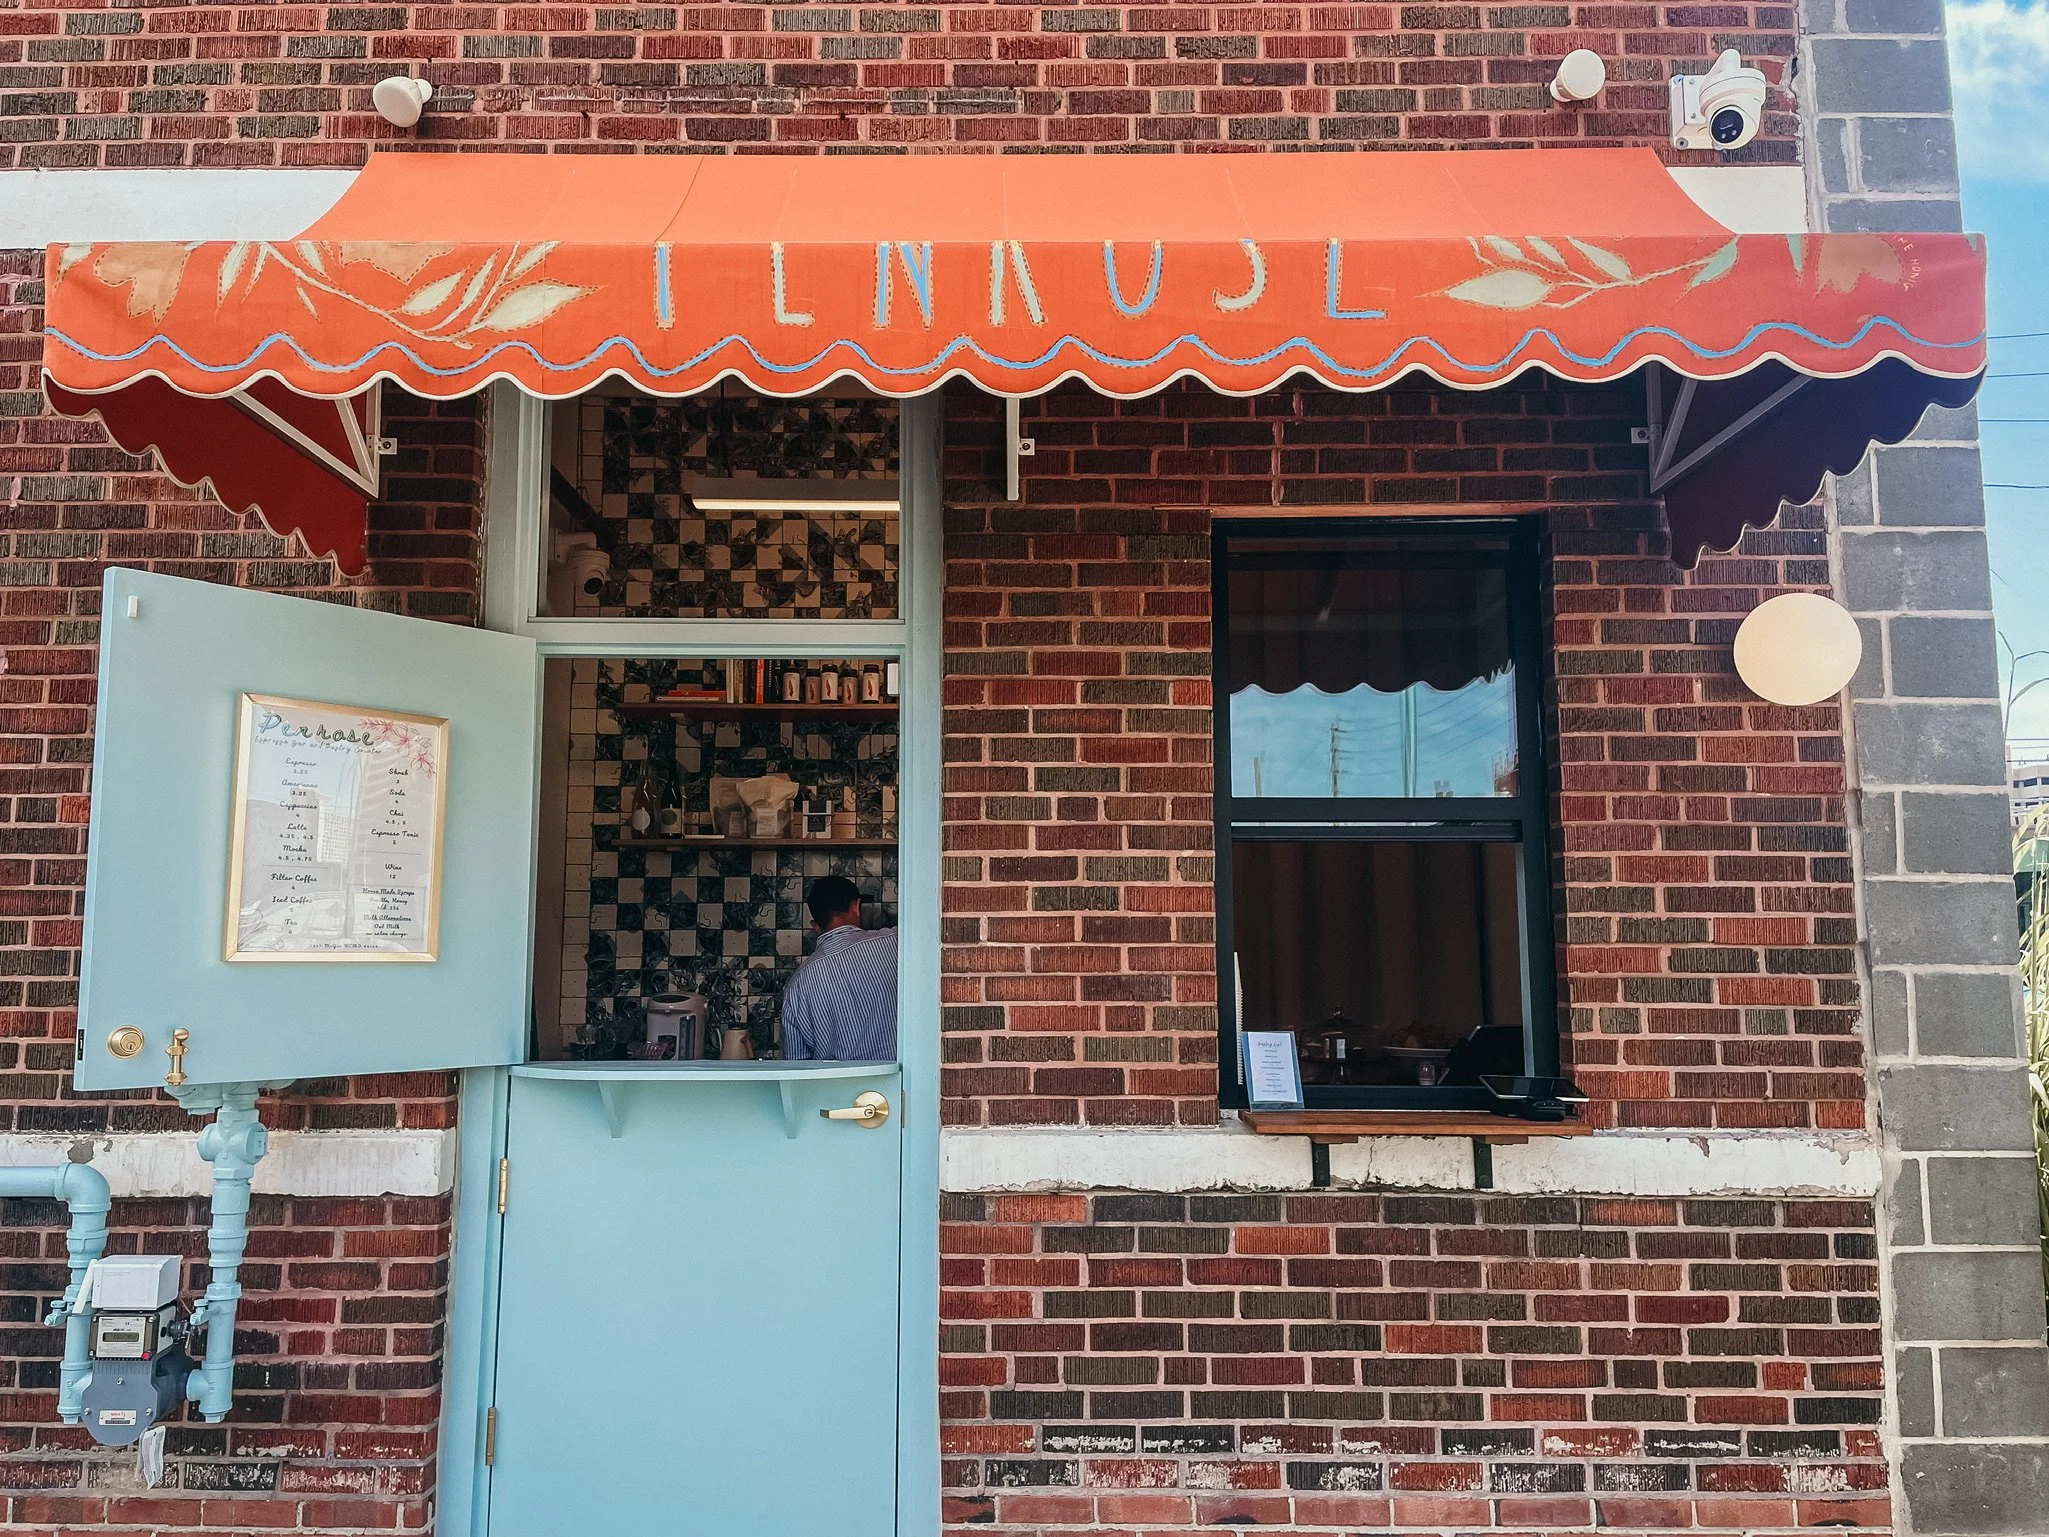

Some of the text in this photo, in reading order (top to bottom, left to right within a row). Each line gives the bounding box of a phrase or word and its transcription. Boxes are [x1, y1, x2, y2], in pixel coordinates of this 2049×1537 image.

[258, 712, 375, 746] Penrose
[286, 757, 317, 767] Espresso
[388, 768, 409, 776] Shrub
[281, 779, 319, 788] Americano
[389, 788, 406, 796] Soda
[280, 800, 318, 811] Cappuccino
[389, 809, 404, 817] Chai
[287, 822, 308, 831] Latte
[370, 829, 419, 838] Espresso Tonic
[282, 844, 308, 853] Mocha
[384, 863, 402, 871] Wine
[270, 872, 318, 884] Filter Coffee
[271, 895, 313, 905] Iced Coffee
[284, 918, 298, 926] Tea
